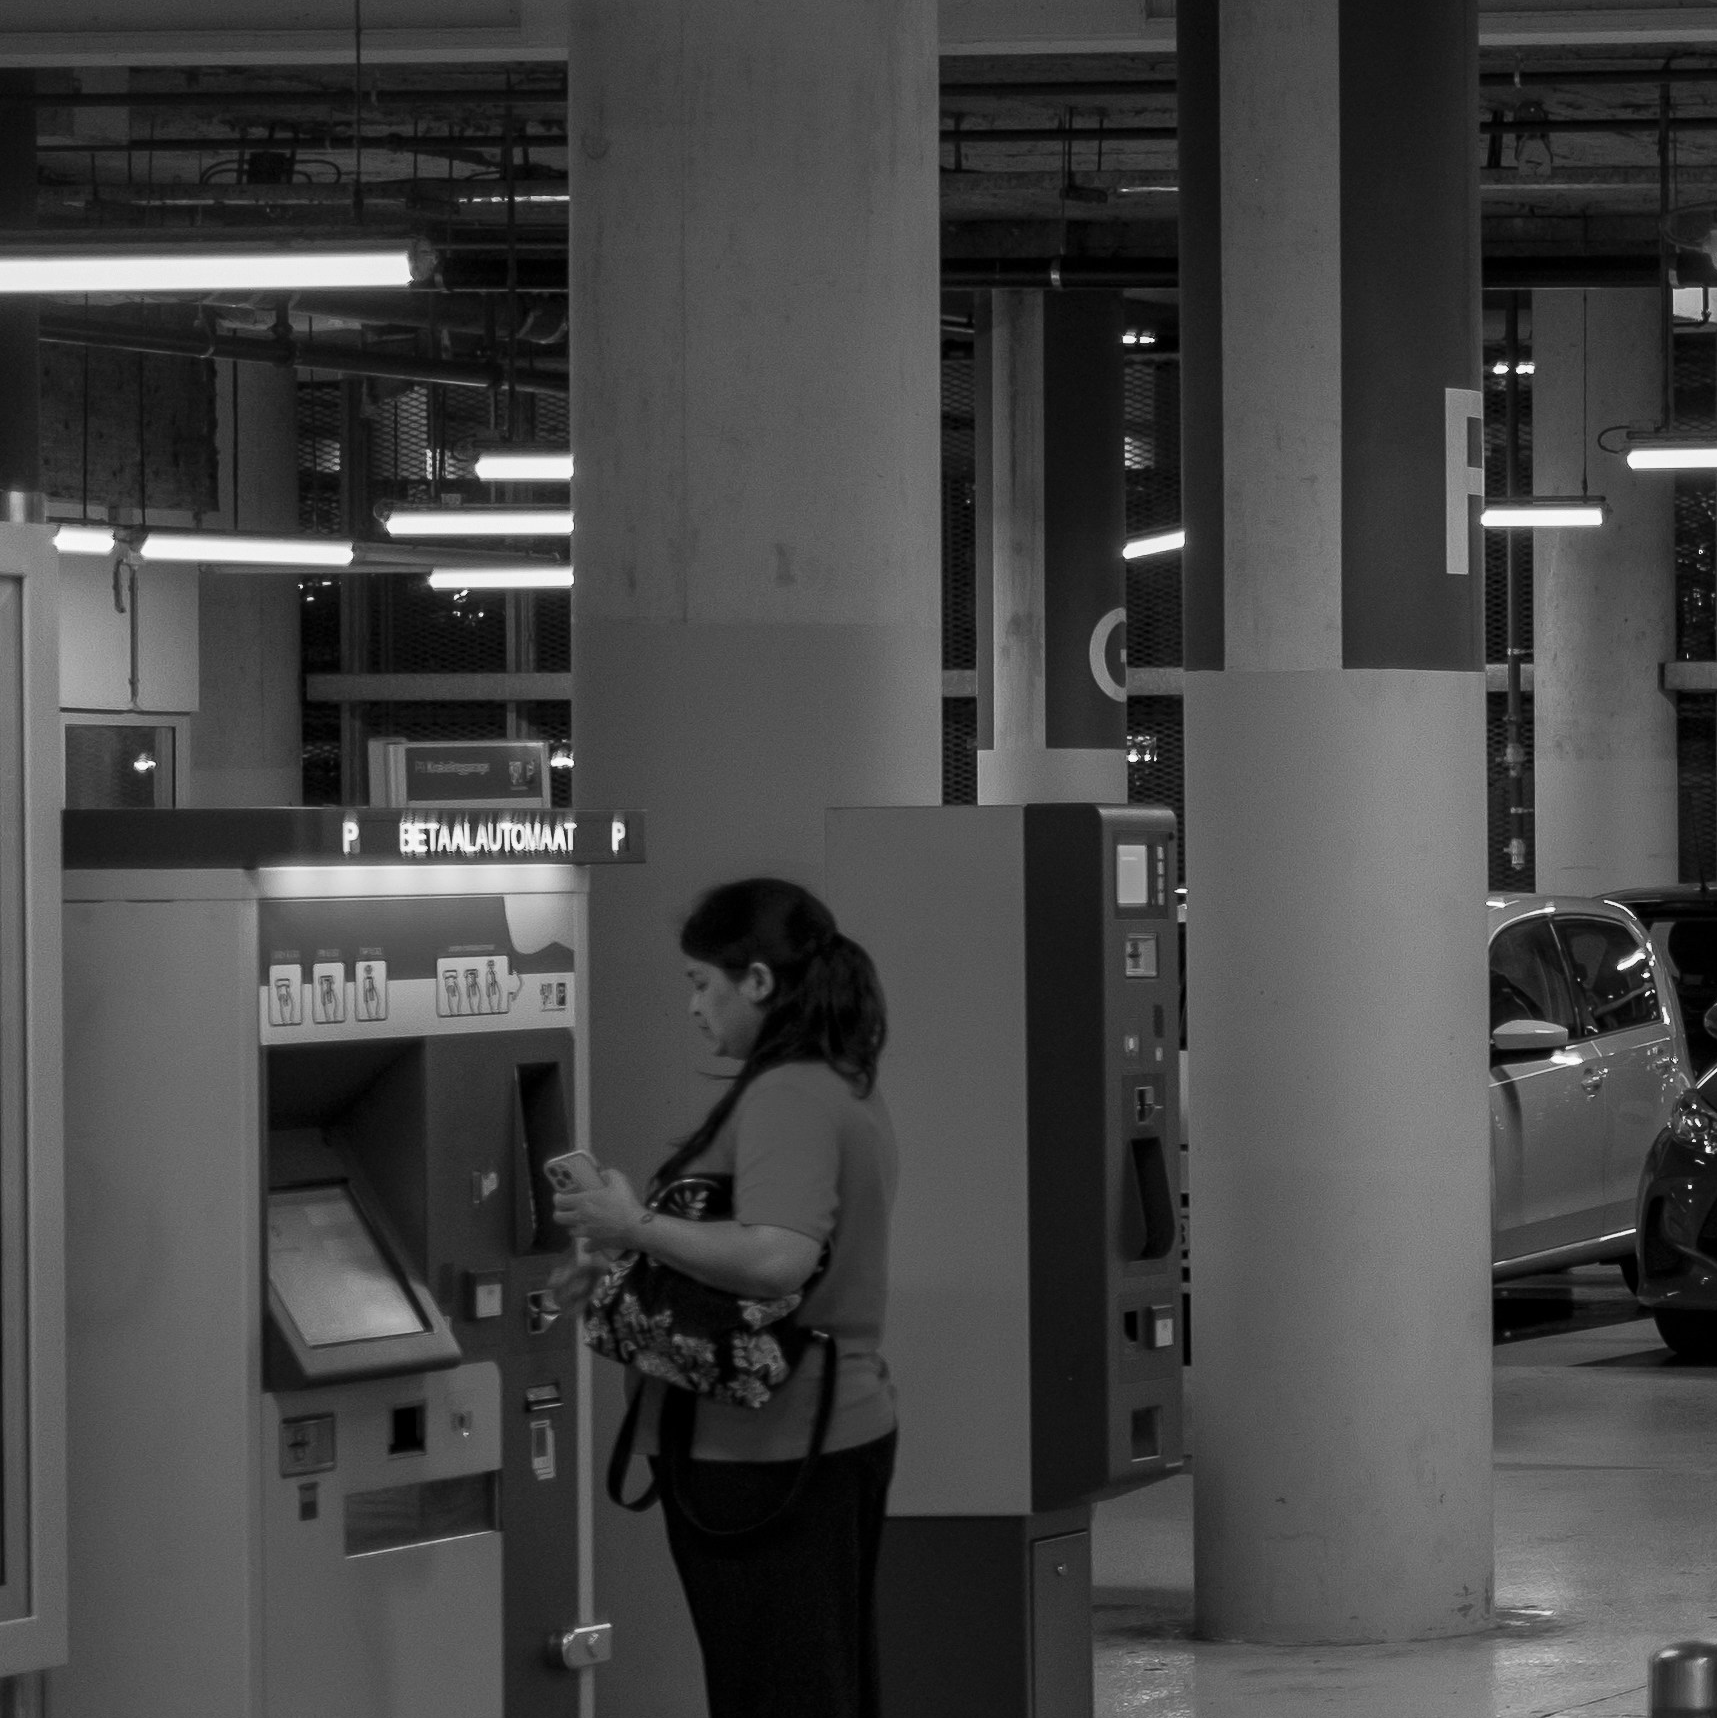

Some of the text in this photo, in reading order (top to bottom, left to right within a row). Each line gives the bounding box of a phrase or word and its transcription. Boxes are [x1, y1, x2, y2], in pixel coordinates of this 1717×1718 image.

[342, 821, 627, 853] P BETAALAUTOMAAT P
